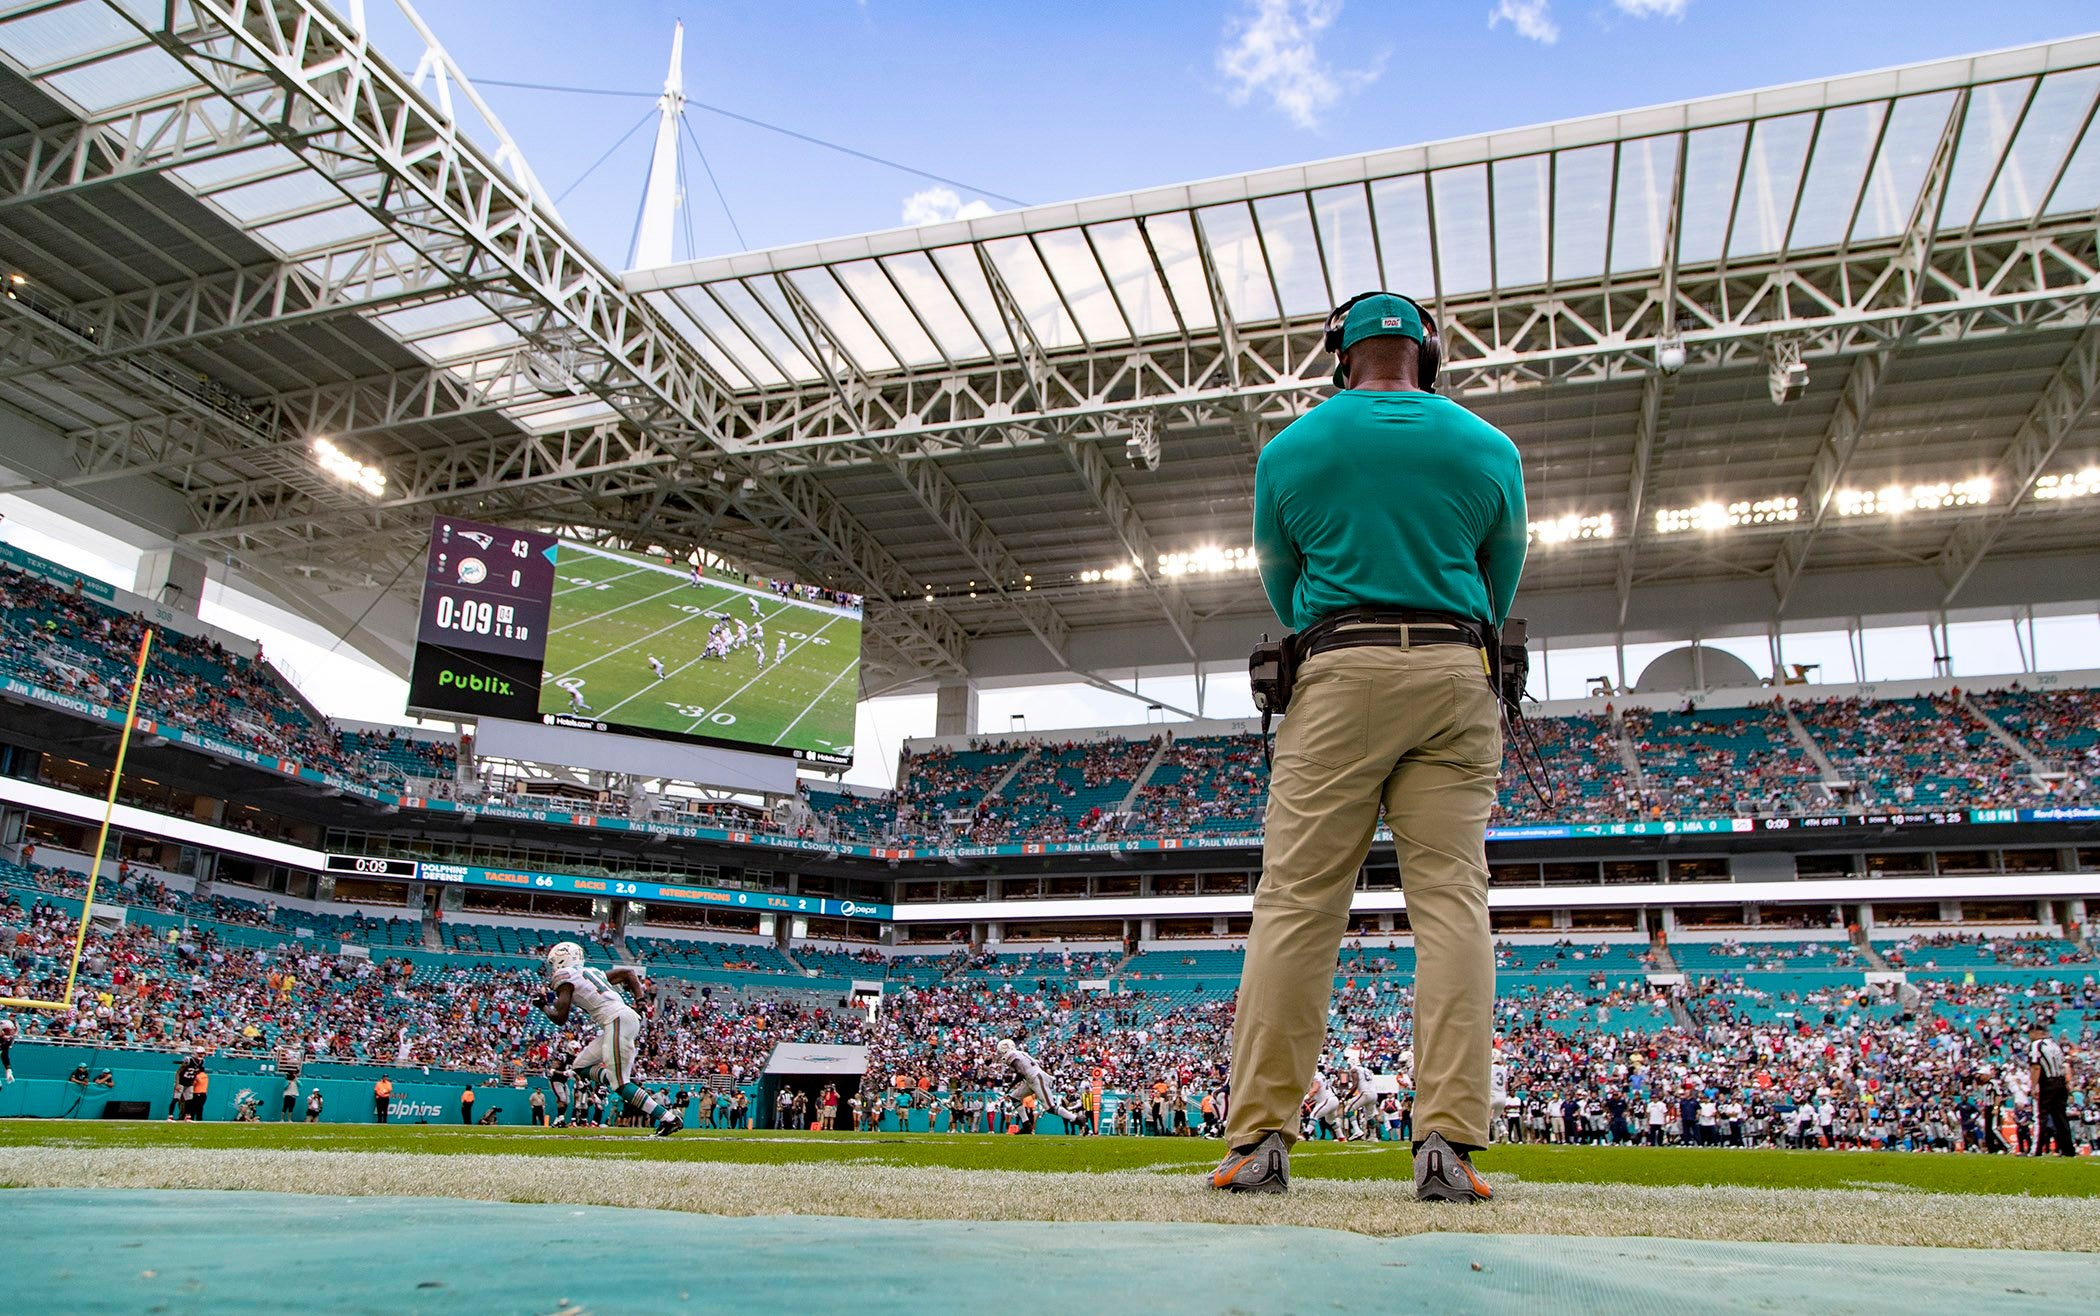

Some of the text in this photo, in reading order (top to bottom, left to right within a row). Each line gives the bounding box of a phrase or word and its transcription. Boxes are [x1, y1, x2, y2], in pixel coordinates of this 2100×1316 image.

[511, 540, 529, 559] 43
[511, 570, 521, 588] 0
[436, 596, 493, 635] 0:09
[515, 626, 529, 641] 10
[6, 679, 108, 719] JIM MANDICH 88
[455, 803, 547, 821] DICK ANDERSON 40
[629, 823, 697, 838] NAT MOORE 89
[1610, 824, 1646, 835] NE 43
[1683, 822, 1704, 832] MIA
[771, 837, 853, 855] LARRY CSONKA 39
[1066, 842, 1139, 852] JIM LANGER 62
[1199, 839, 1222, 848] PAUL
[938, 847, 998, 857] BOB GRIESE 12
[356, 859, 388, 873] 0:09
[421, 863, 468, 875] DOLPHINS
[422, 872, 465, 882] DEFENSE
[484, 872, 529, 884] TACKLES
[535, 875, 553, 887] 66
[574, 880, 606, 891] SACKS
[615, 883, 636, 894] 2.0
[659, 887, 730, 902] INTERCEPTIONS
[738, 894, 747, 904] 0
[799, 900, 807, 909] 2
[855, 906, 877, 915] pepsi
[388, 1100, 442, 1119] olphins
